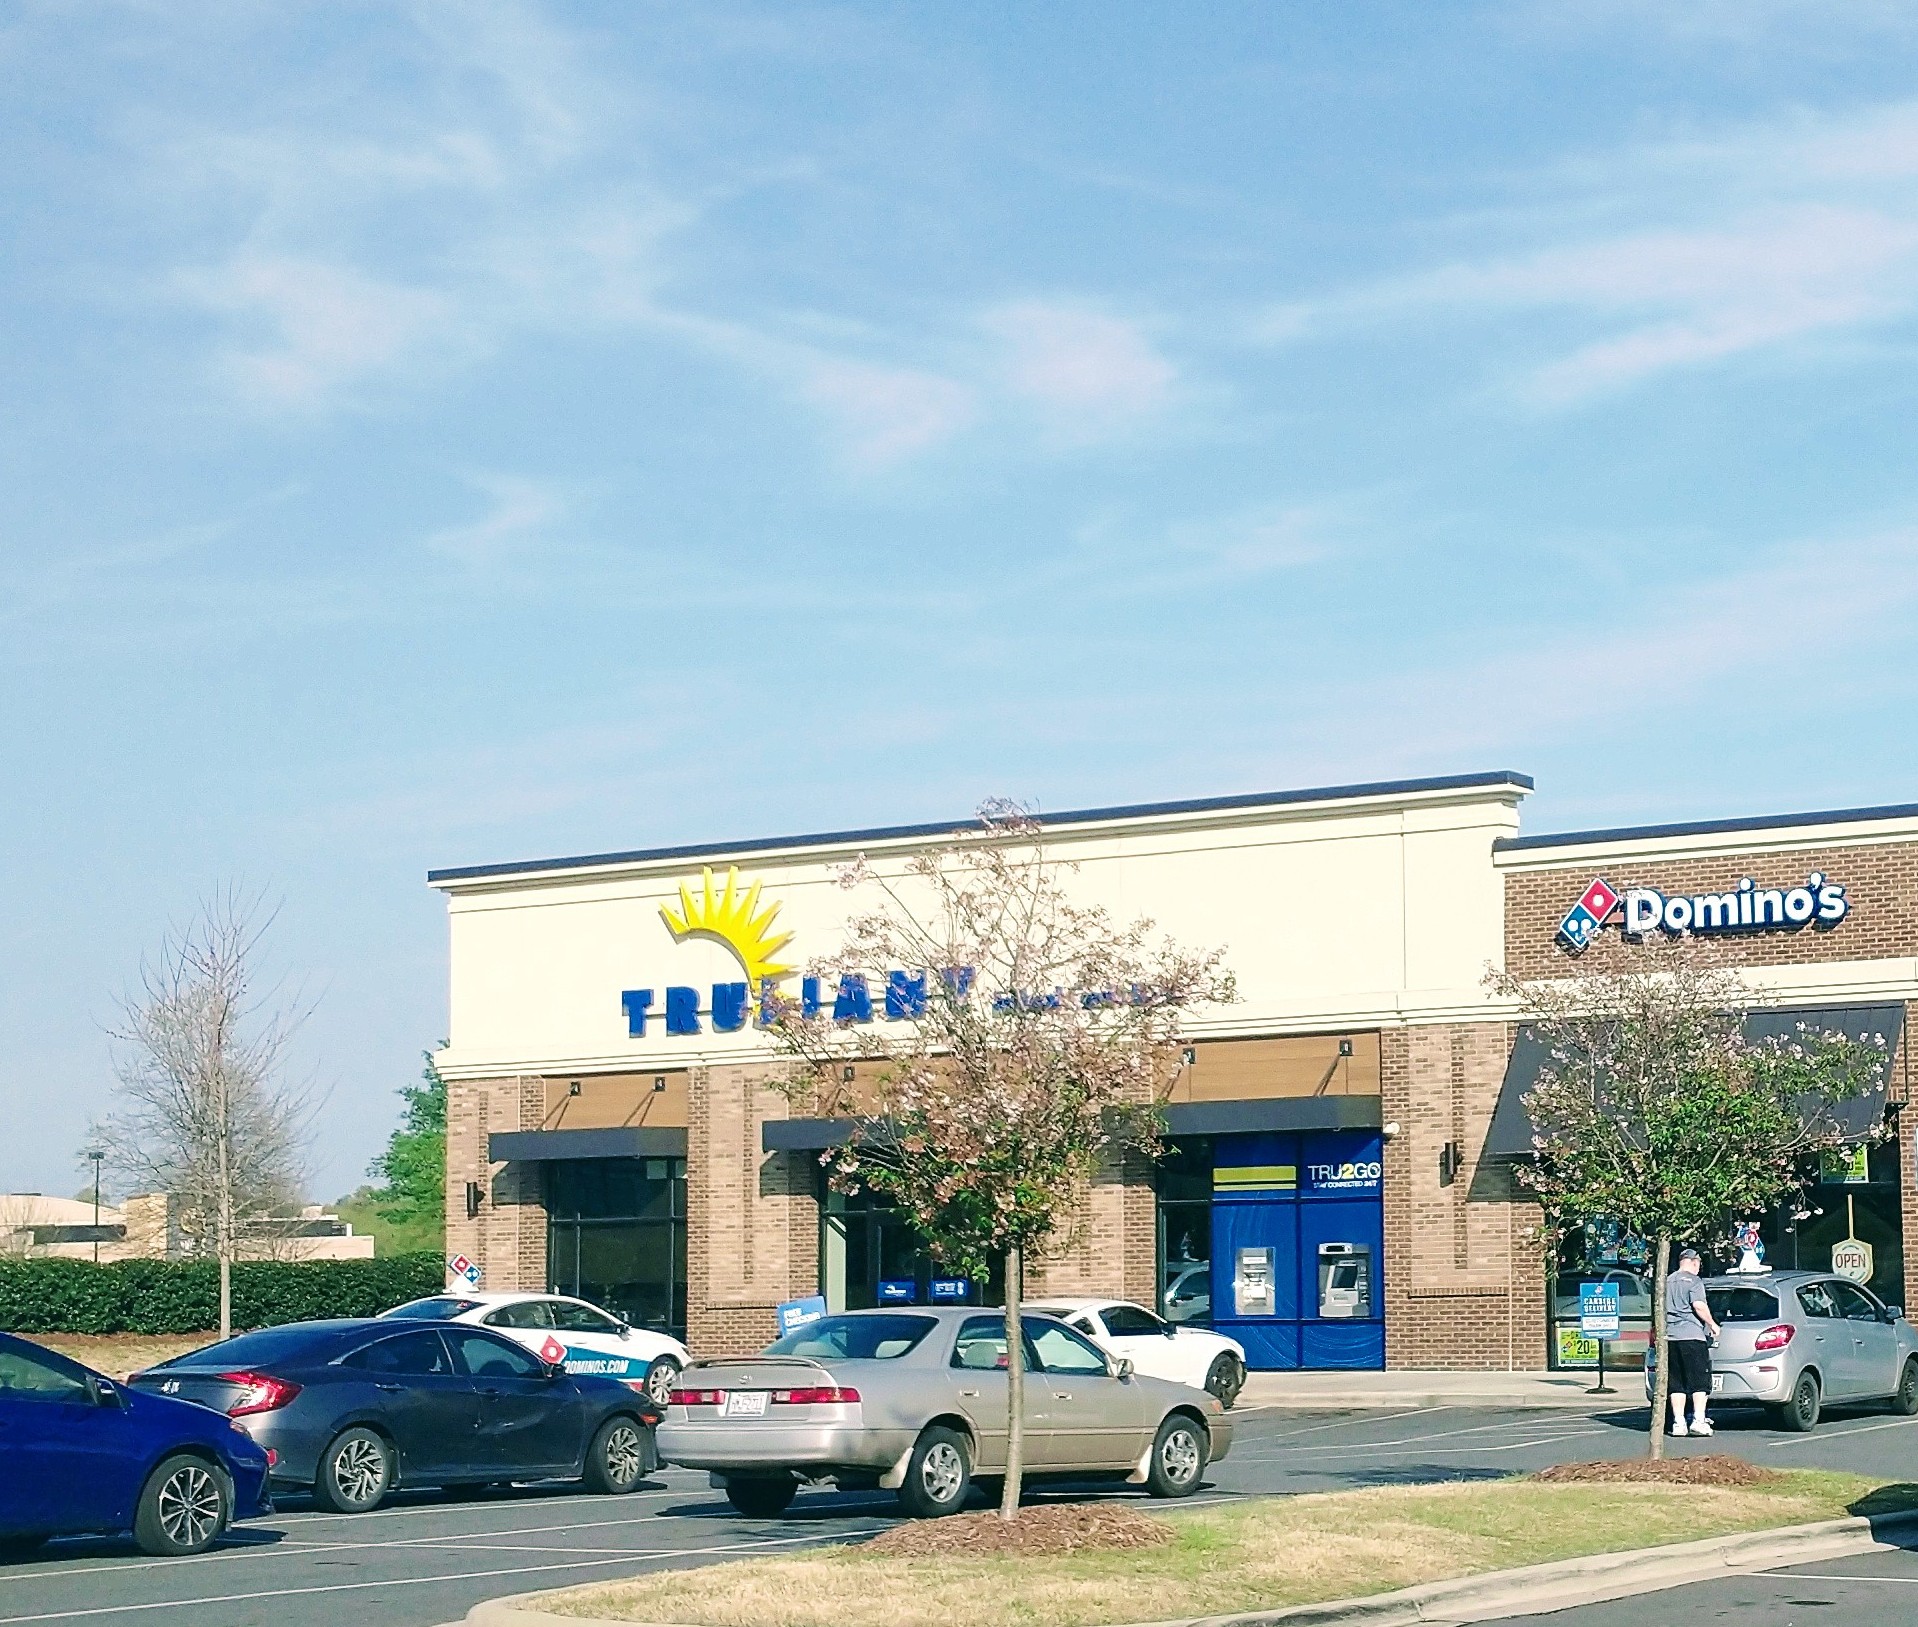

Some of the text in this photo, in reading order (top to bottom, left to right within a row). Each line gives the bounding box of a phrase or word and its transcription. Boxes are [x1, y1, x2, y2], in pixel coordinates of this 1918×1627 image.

[1626, 872, 1847, 934] Domino's
[1307, 1162, 1382, 1180] TRU2GO
[1835, 1253, 1866, 1268] OPEN
[564, 1360, 629, 1375] DOMINOS.COM
